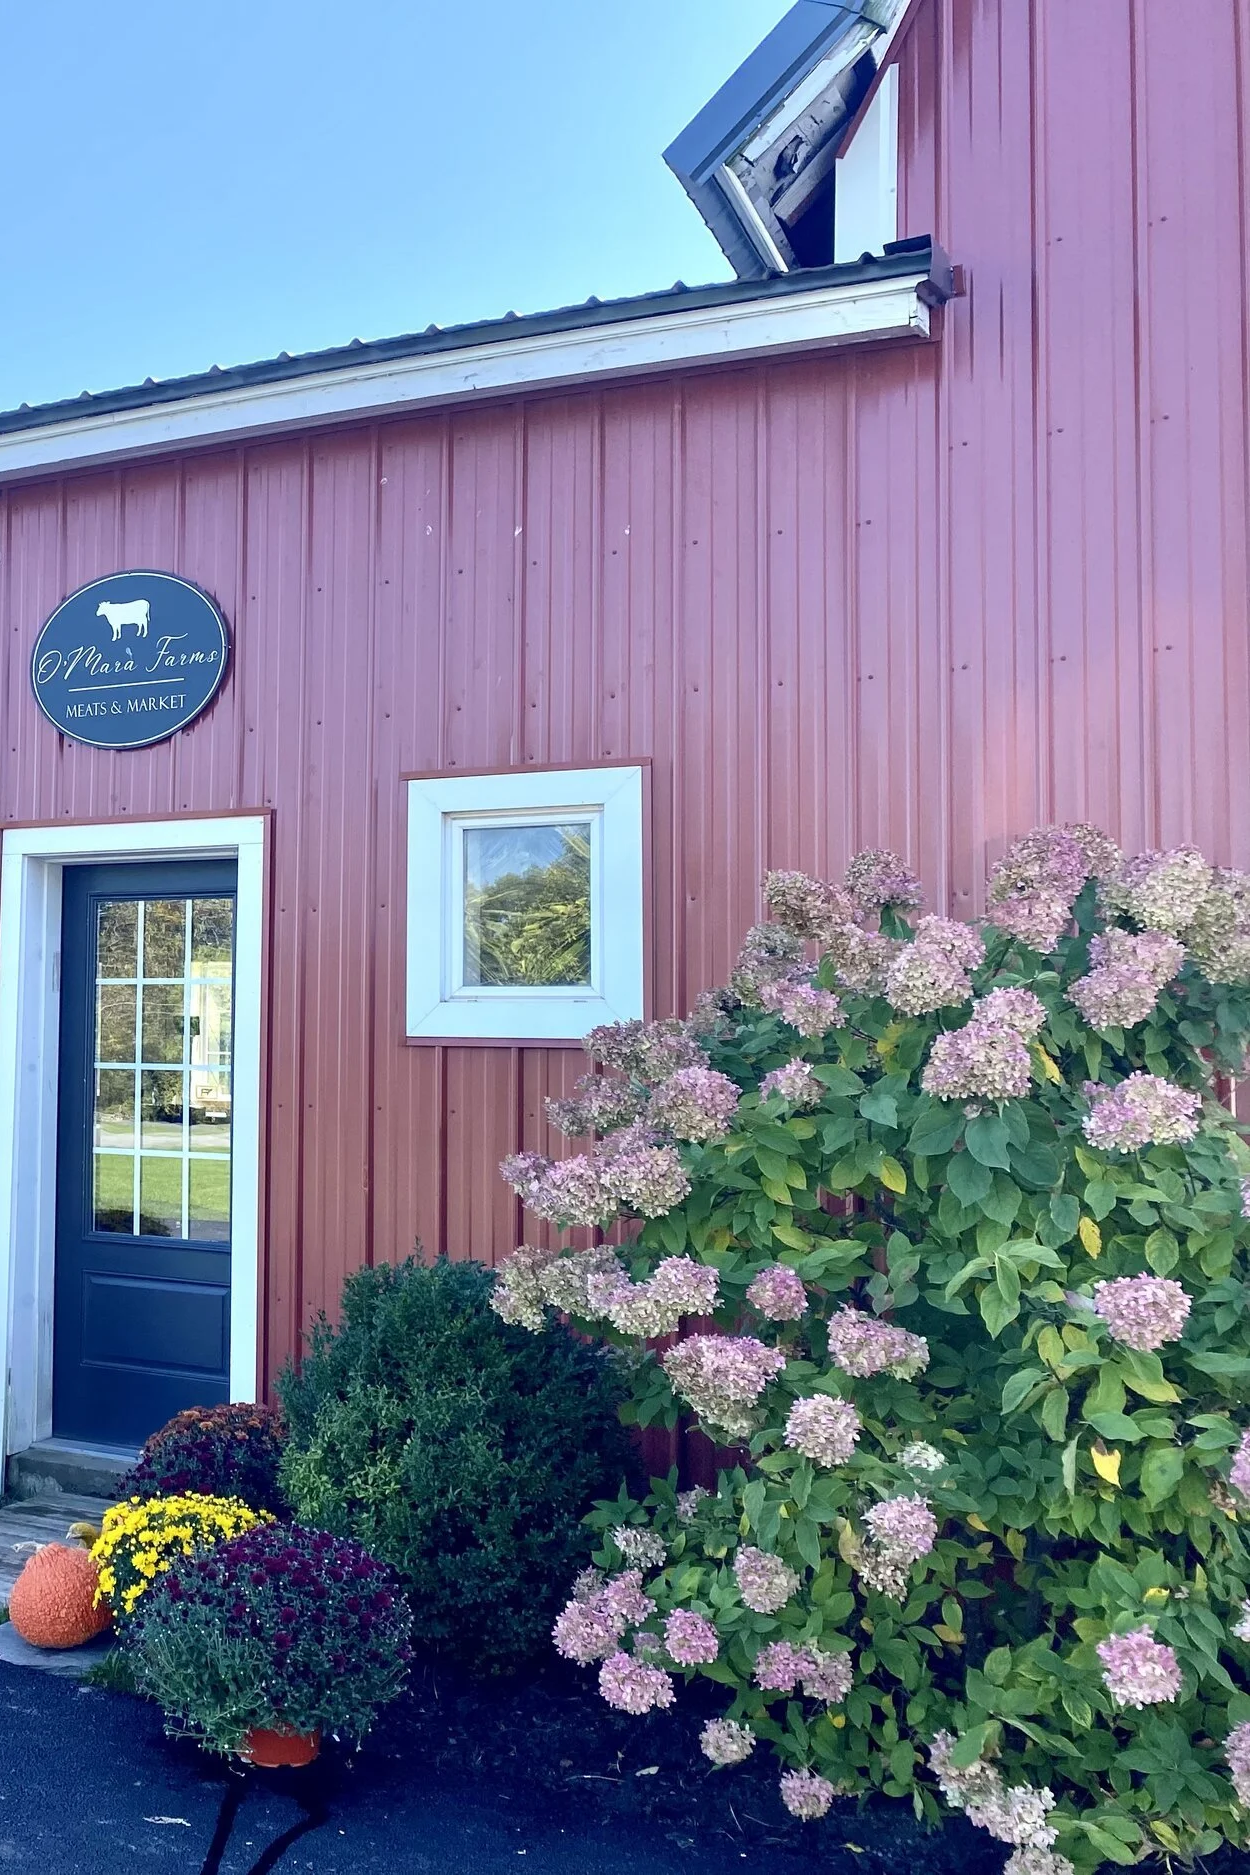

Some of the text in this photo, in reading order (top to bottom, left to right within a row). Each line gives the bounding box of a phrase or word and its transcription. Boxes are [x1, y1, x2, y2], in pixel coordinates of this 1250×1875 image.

[37, 632, 219, 684] O'Mara Farms
[66, 694, 186, 719] MEATS & MARKET
